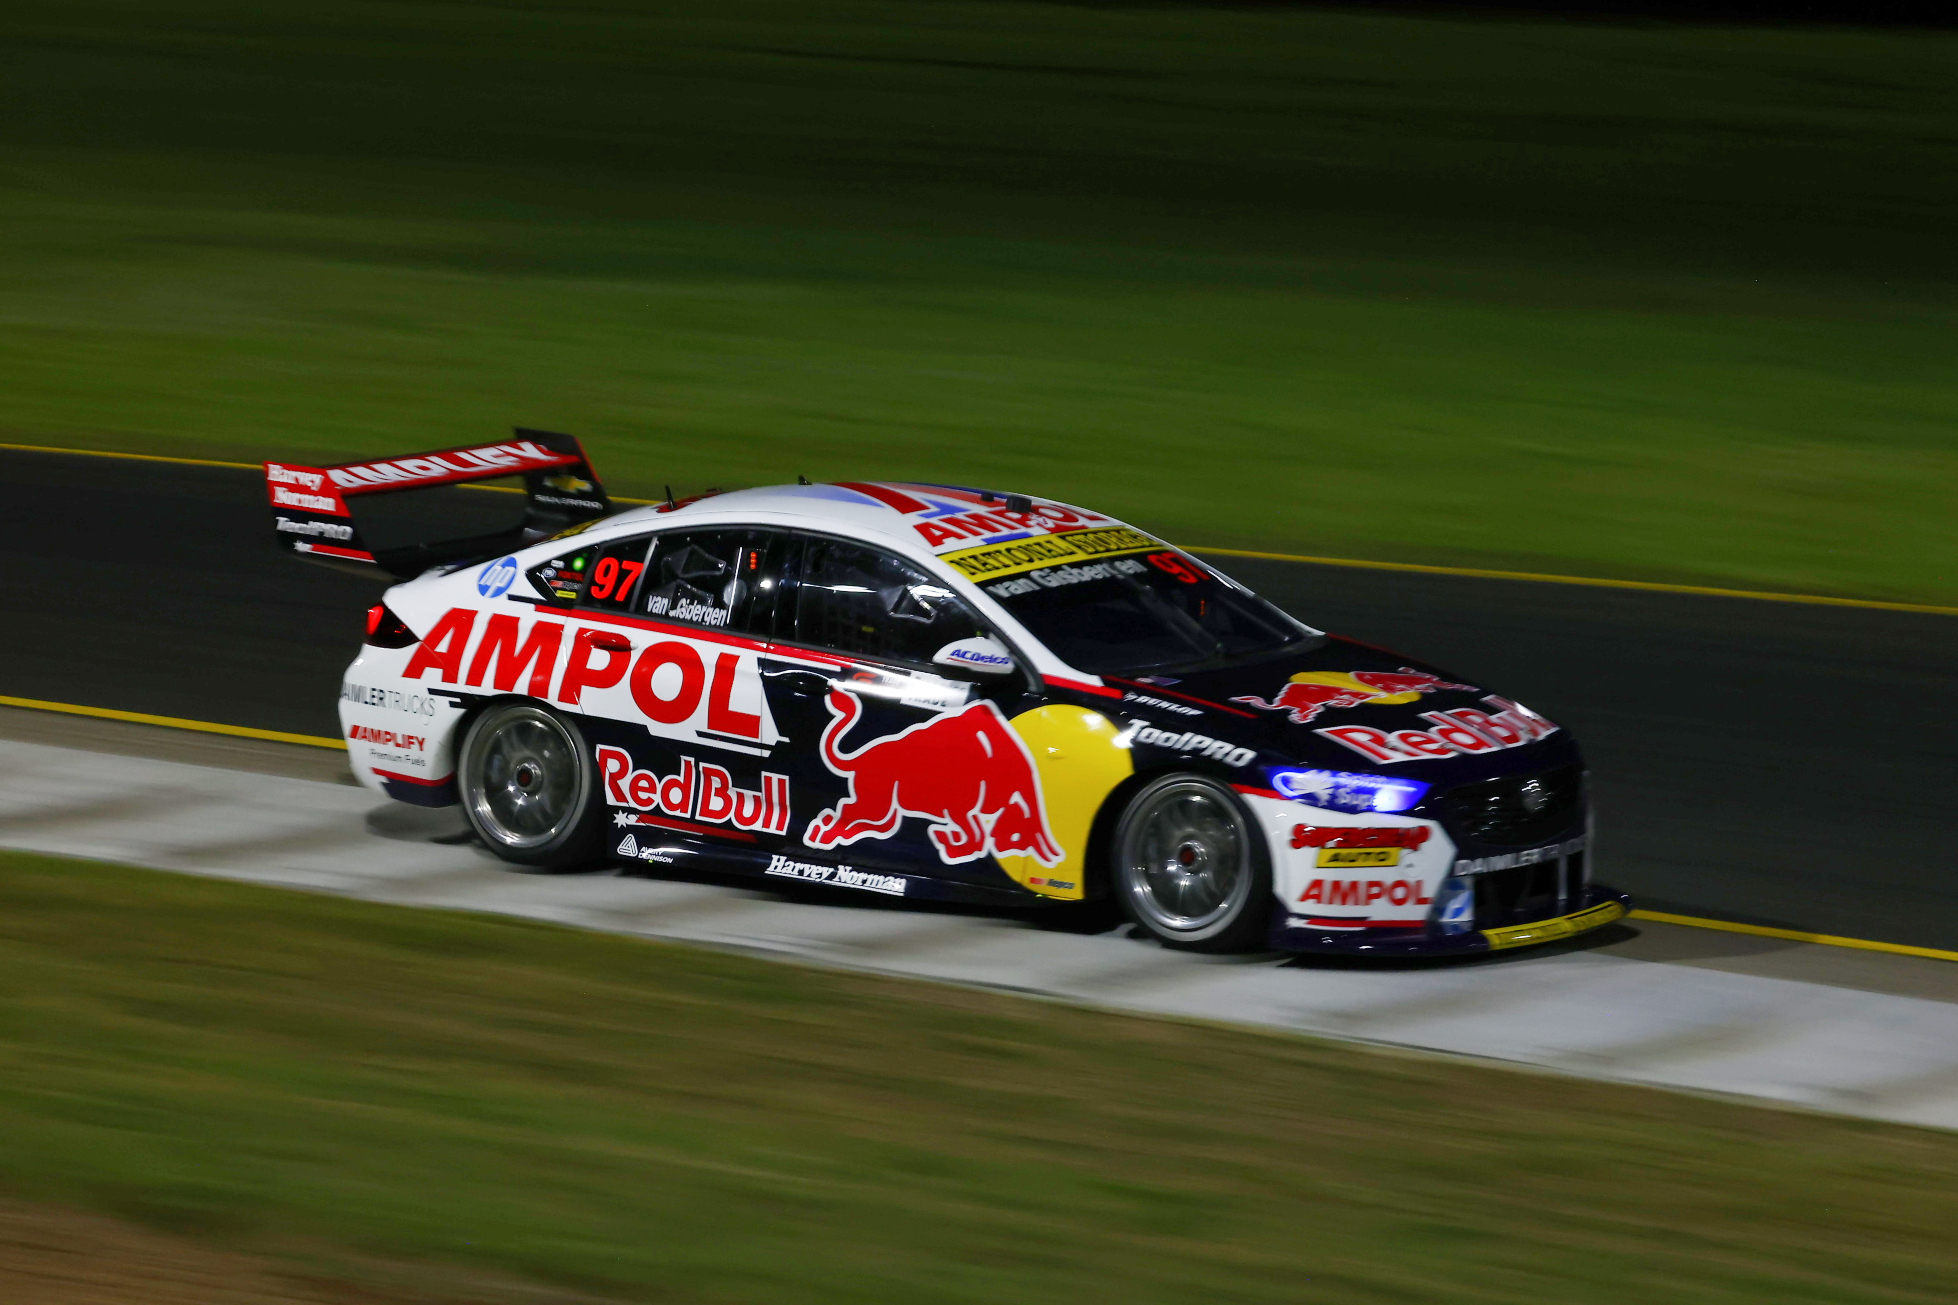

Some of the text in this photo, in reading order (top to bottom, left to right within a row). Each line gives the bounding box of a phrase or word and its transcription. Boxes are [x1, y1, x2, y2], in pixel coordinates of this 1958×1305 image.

[267, 464, 325, 491] Harvey
[327, 441, 558, 488] AMPLIFY
[273, 486, 336, 512] Norman
[913, 504, 1110, 548] AMPOL
[950, 539, 1078, 576] NATIONAL
[479, 557, 517, 598] hp
[591, 557, 644, 602] 97
[986, 576, 1041, 599] van
[647, 595, 669, 616] van
[402, 607, 761, 739] AMPOL
[352, 725, 425, 752] AMPLIFY
[1128, 719, 1258, 768] ToolPRO
[1312, 711, 1502, 764] Red
[596, 744, 790, 836] Red Bull
[768, 855, 907, 893] Harvey Norman
[1298, 880, 1433, 905] AMPOL
